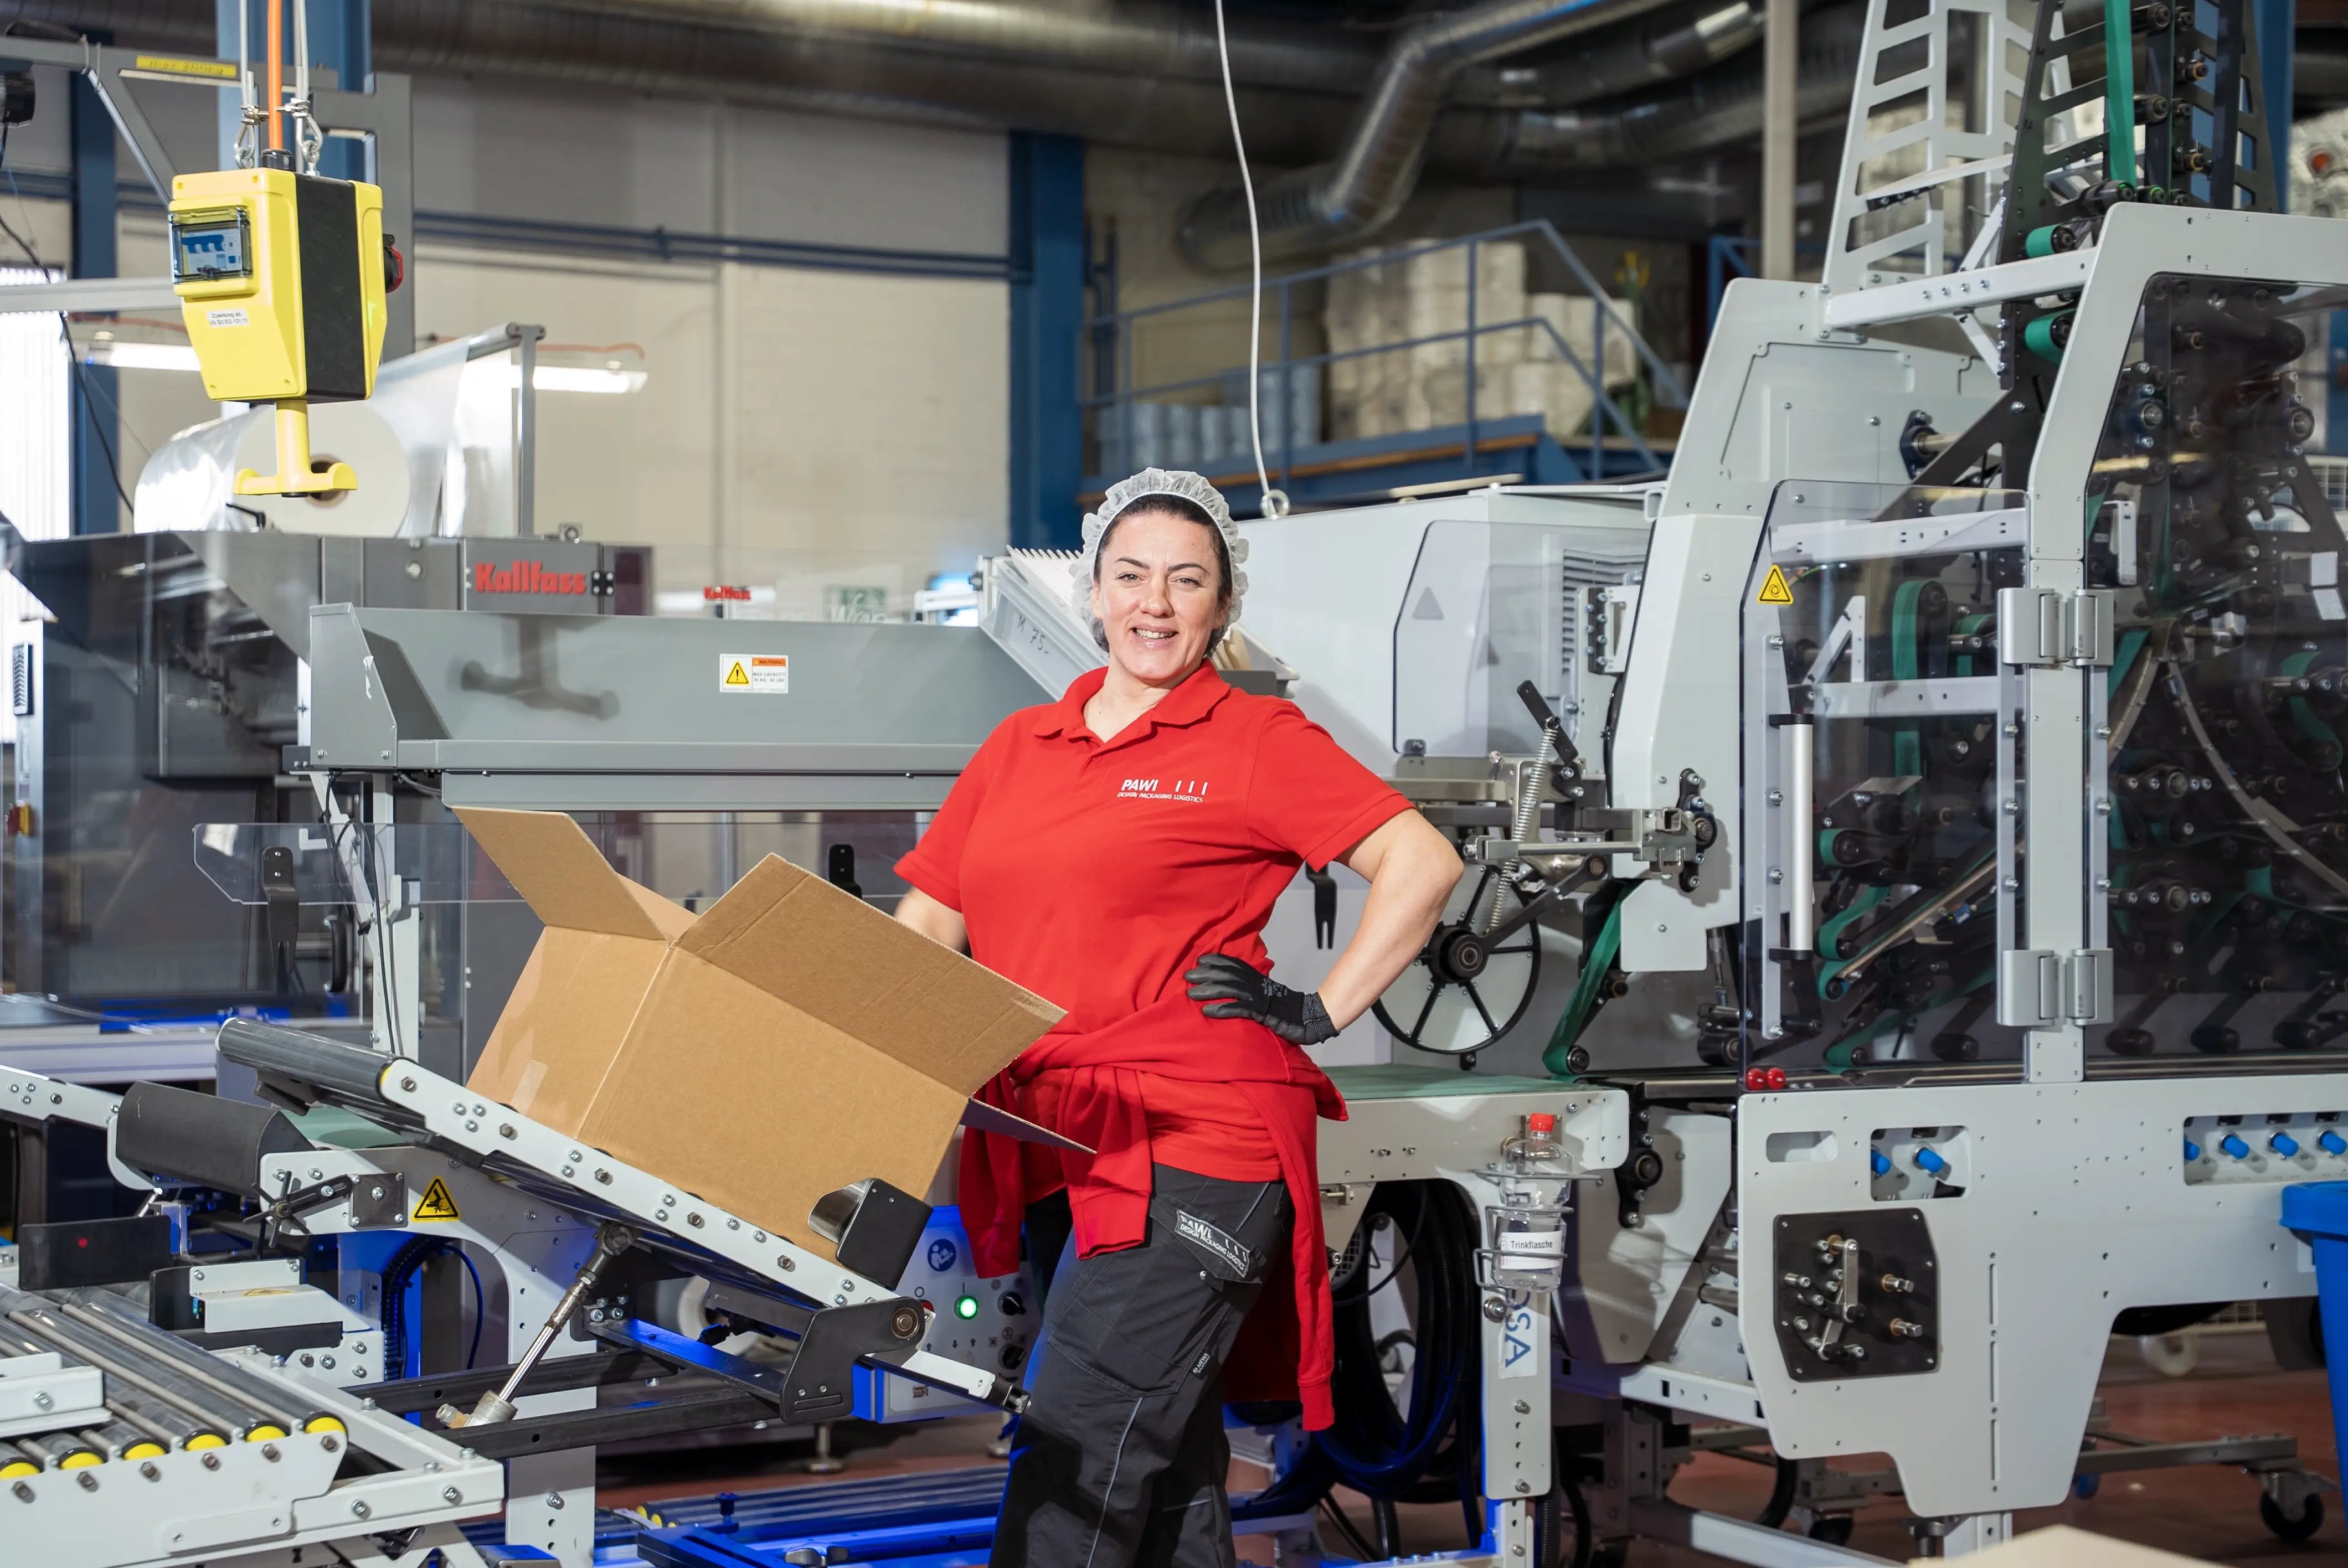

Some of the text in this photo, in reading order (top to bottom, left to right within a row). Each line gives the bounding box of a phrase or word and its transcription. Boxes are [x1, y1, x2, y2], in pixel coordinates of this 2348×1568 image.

[476, 560, 587, 595] Kallfass
[1121, 779, 1158, 791] PAWI
[1180, 1224, 1245, 1270] DESIGN PACKAGING LOGISTICS
[1511, 1240, 1553, 1249] Trinkflasche
